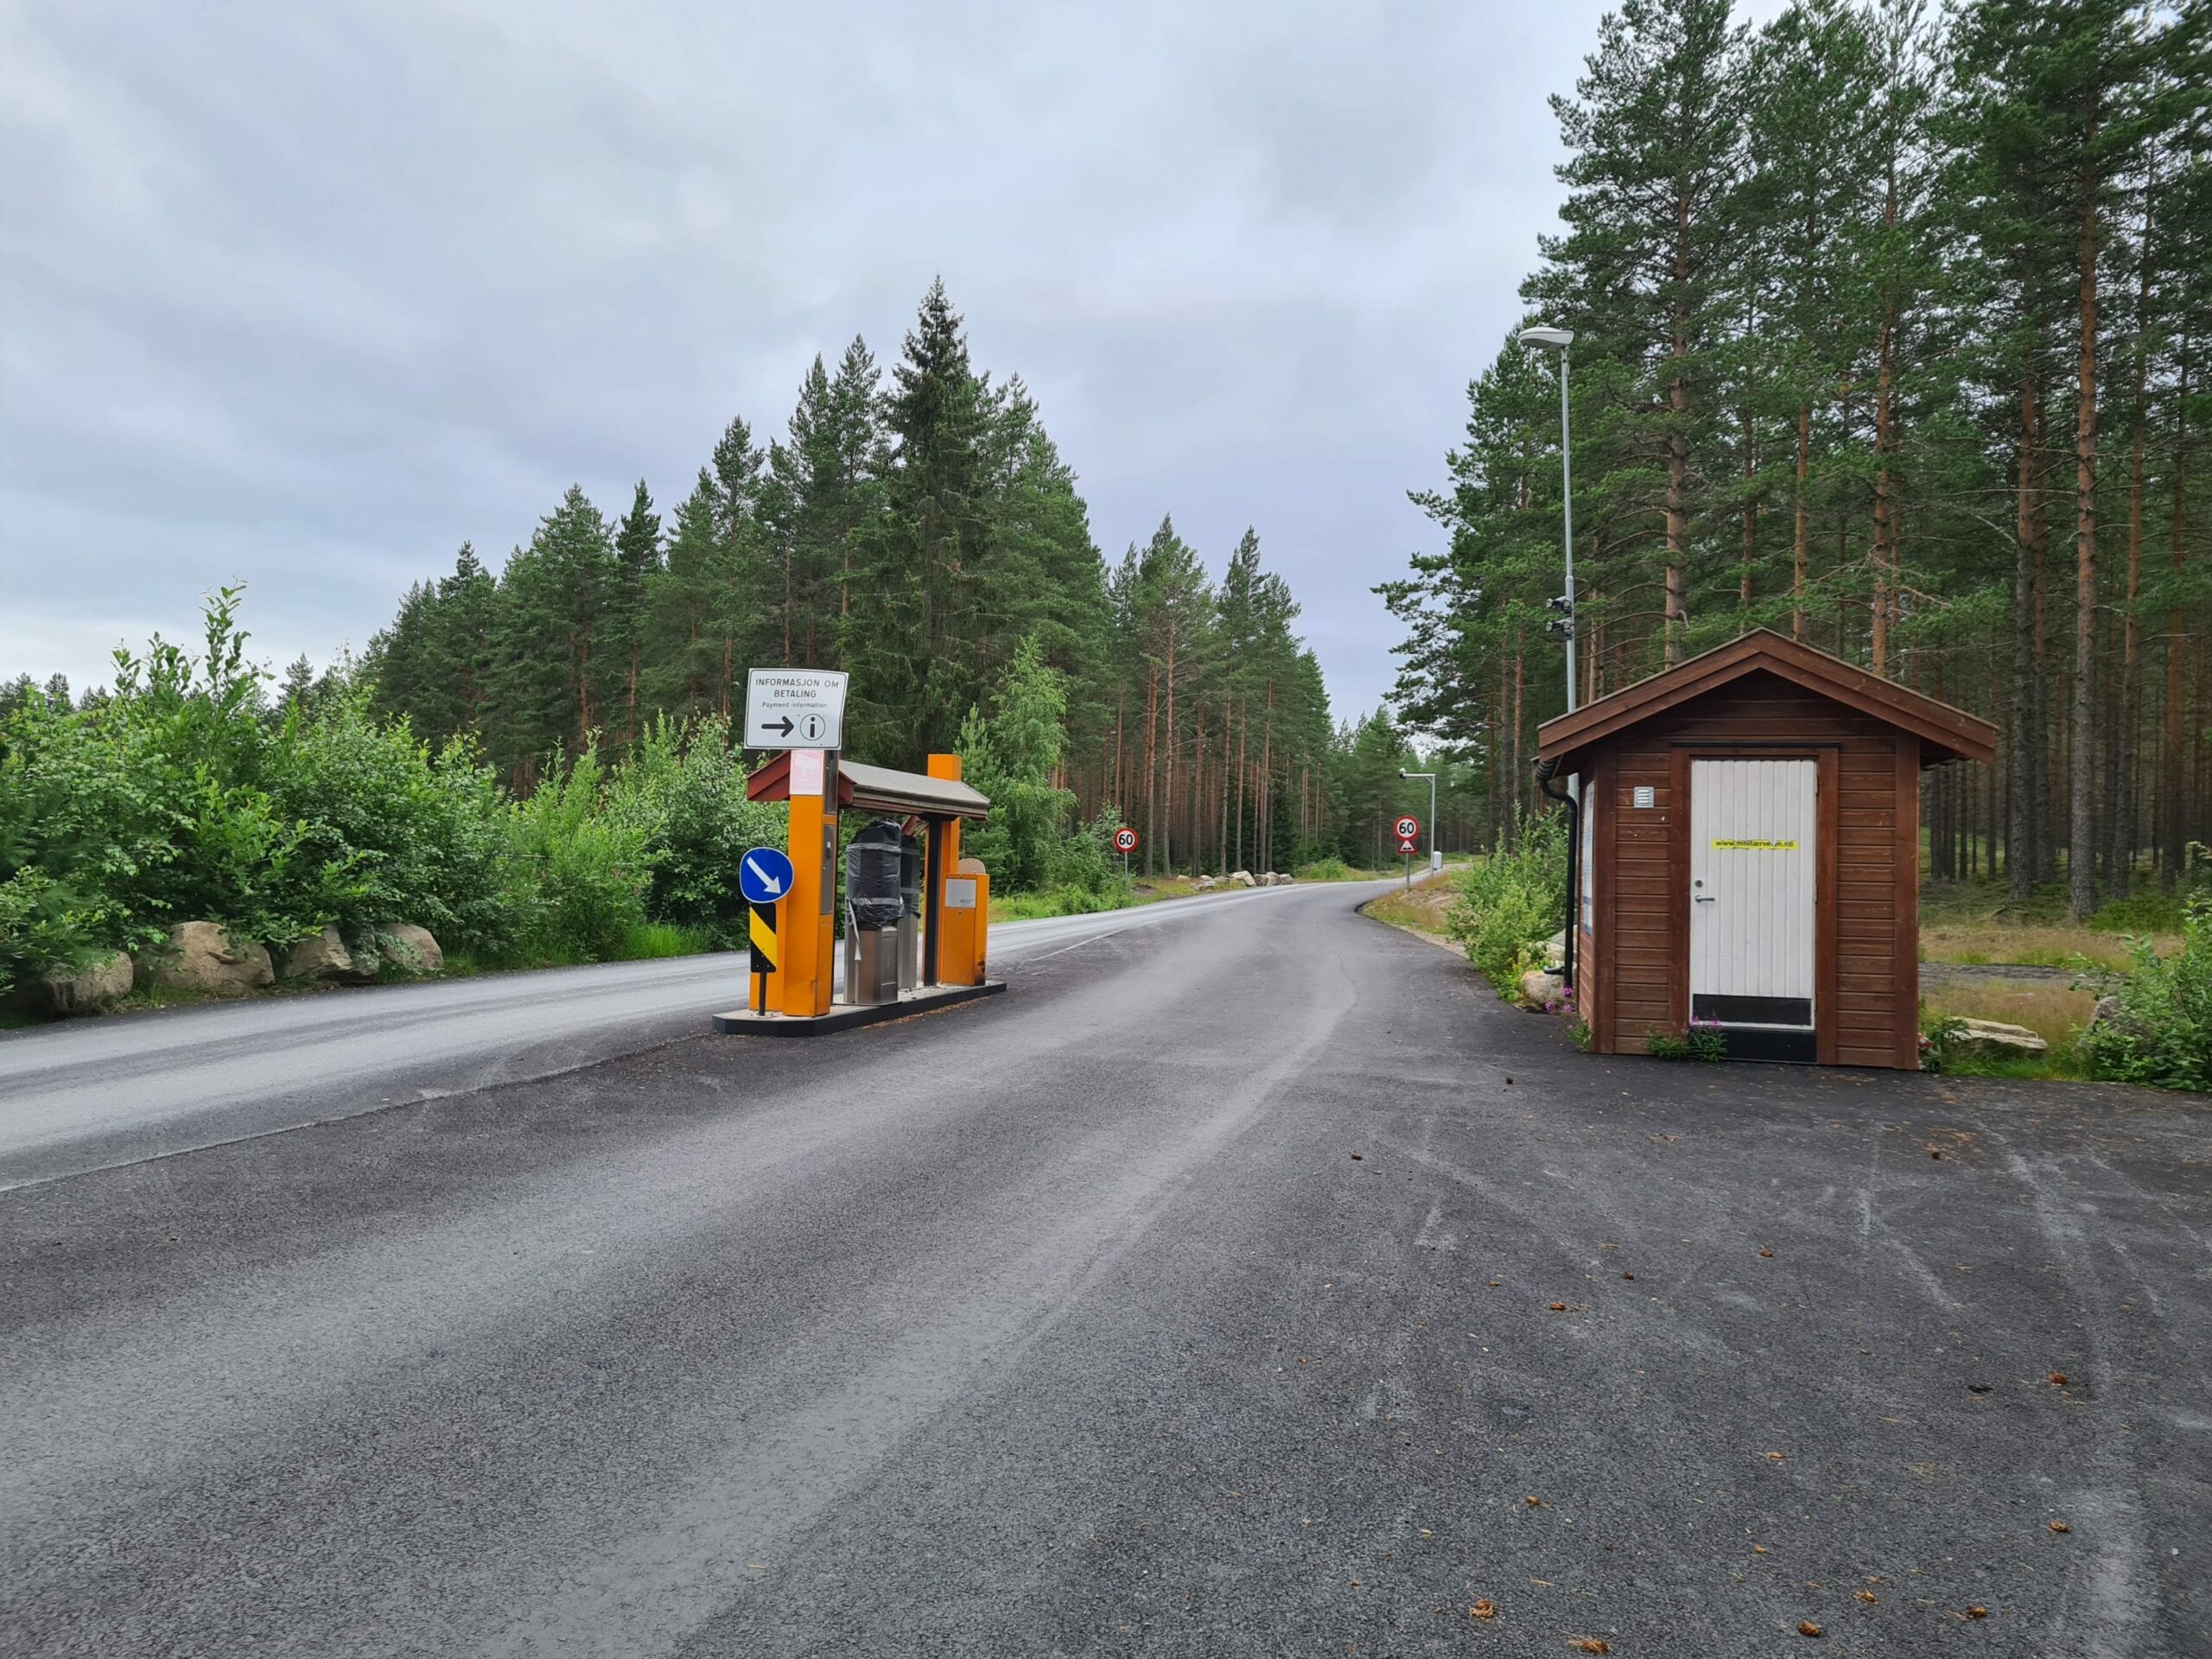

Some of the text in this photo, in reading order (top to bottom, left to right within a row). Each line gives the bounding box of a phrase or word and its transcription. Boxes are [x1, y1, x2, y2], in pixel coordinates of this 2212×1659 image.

[755, 677, 839, 688] INFORMASJON OM
[773, 689, 817, 698] BETALING
[1399, 822, 1414, 834] 60
[1118, 834, 1134, 845] 60
